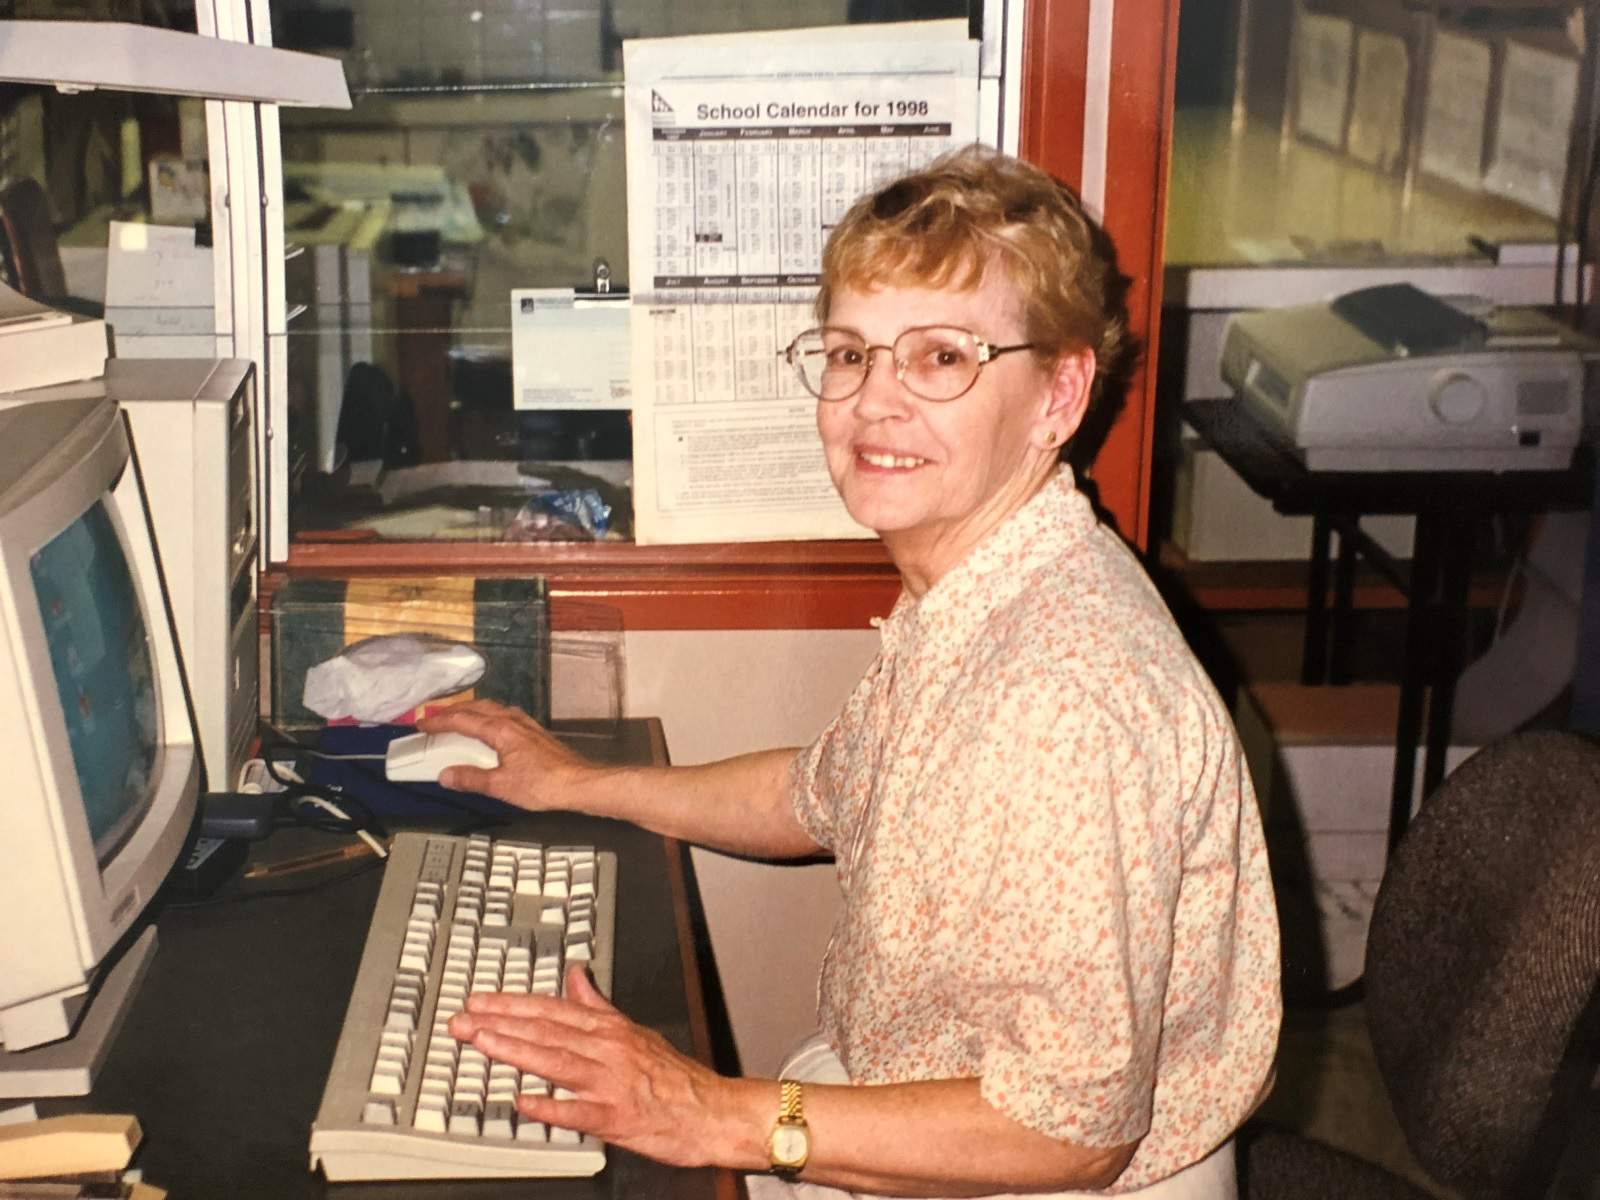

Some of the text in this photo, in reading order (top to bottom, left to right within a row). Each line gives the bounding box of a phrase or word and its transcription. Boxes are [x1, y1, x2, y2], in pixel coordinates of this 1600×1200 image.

[697, 100, 928, 120] School Calendar for 1998
